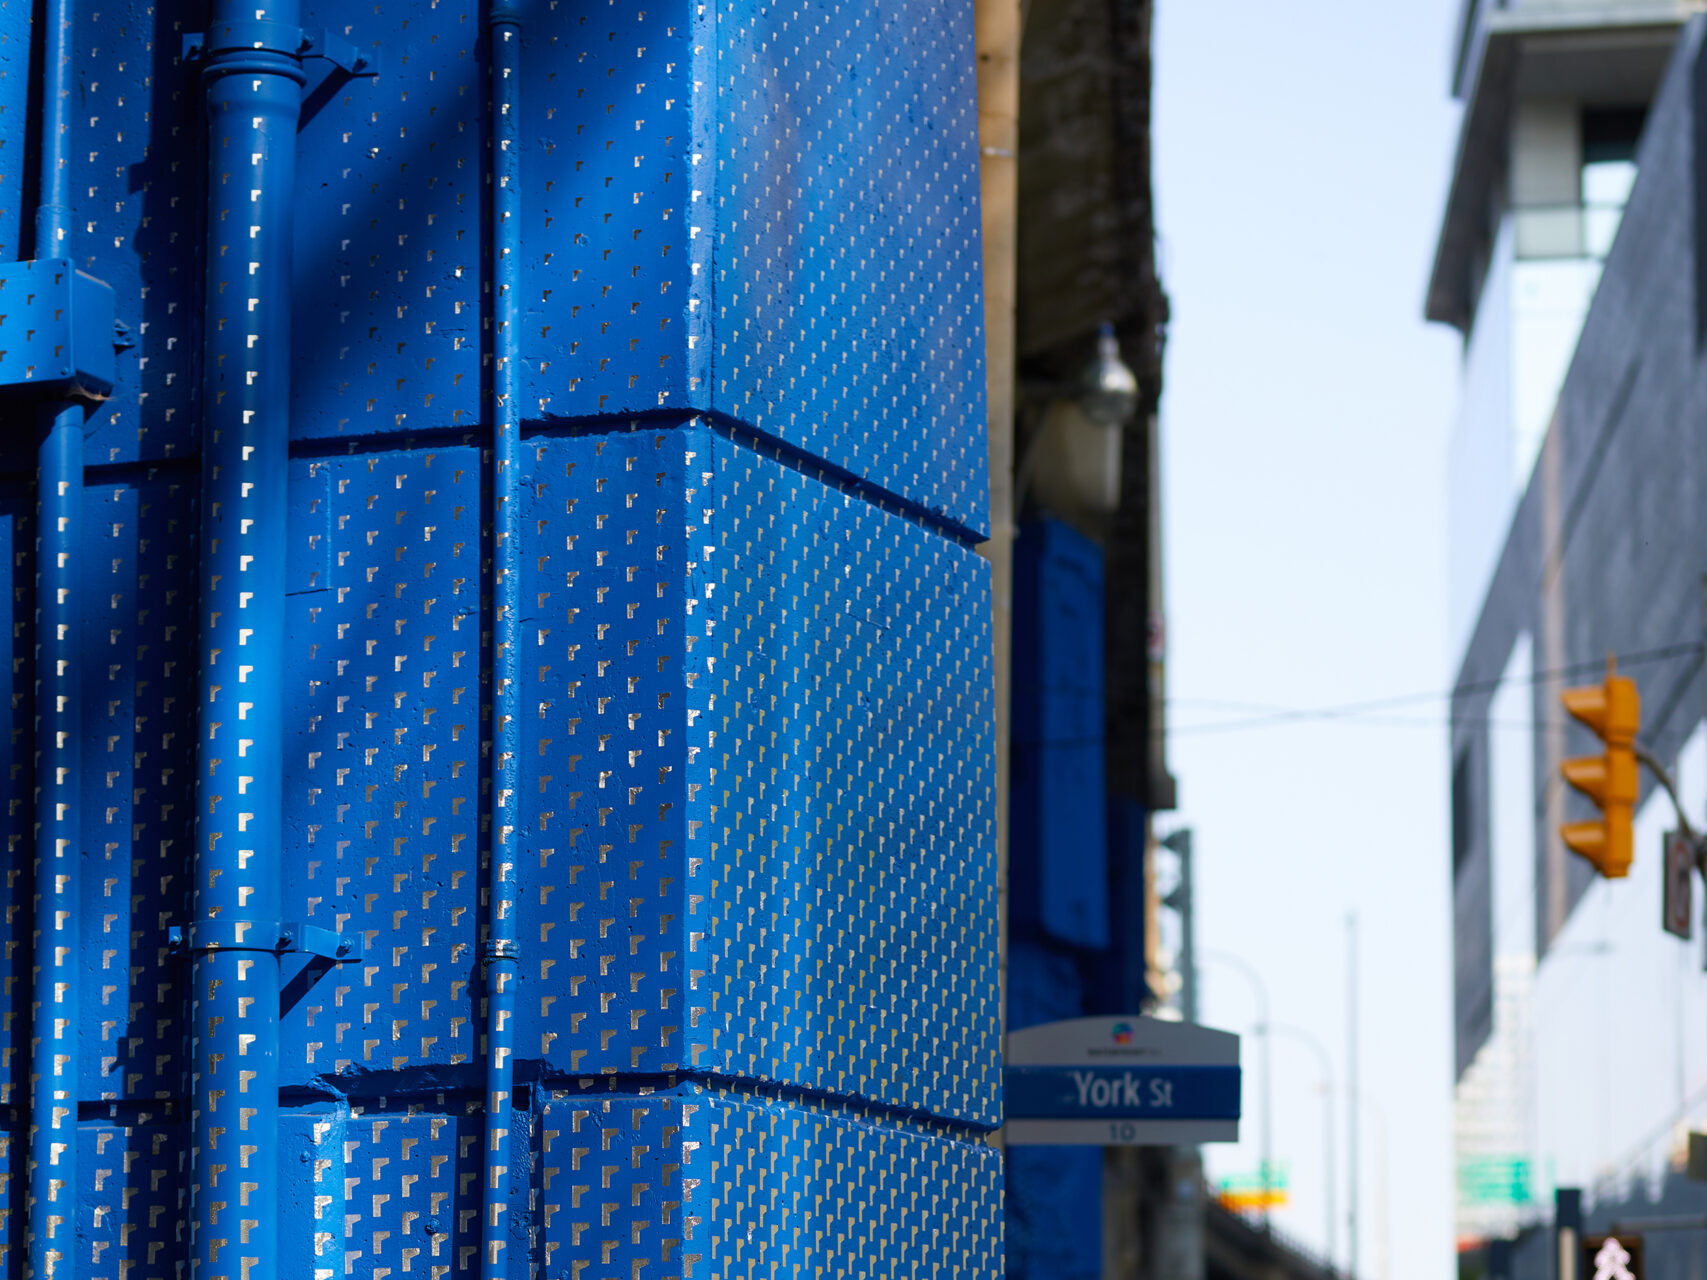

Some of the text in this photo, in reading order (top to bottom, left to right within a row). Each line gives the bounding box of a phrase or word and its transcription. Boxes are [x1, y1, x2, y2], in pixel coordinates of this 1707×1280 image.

[1074, 1071, 1172, 1107] York St
[1110, 1123, 1136, 1141] 10
